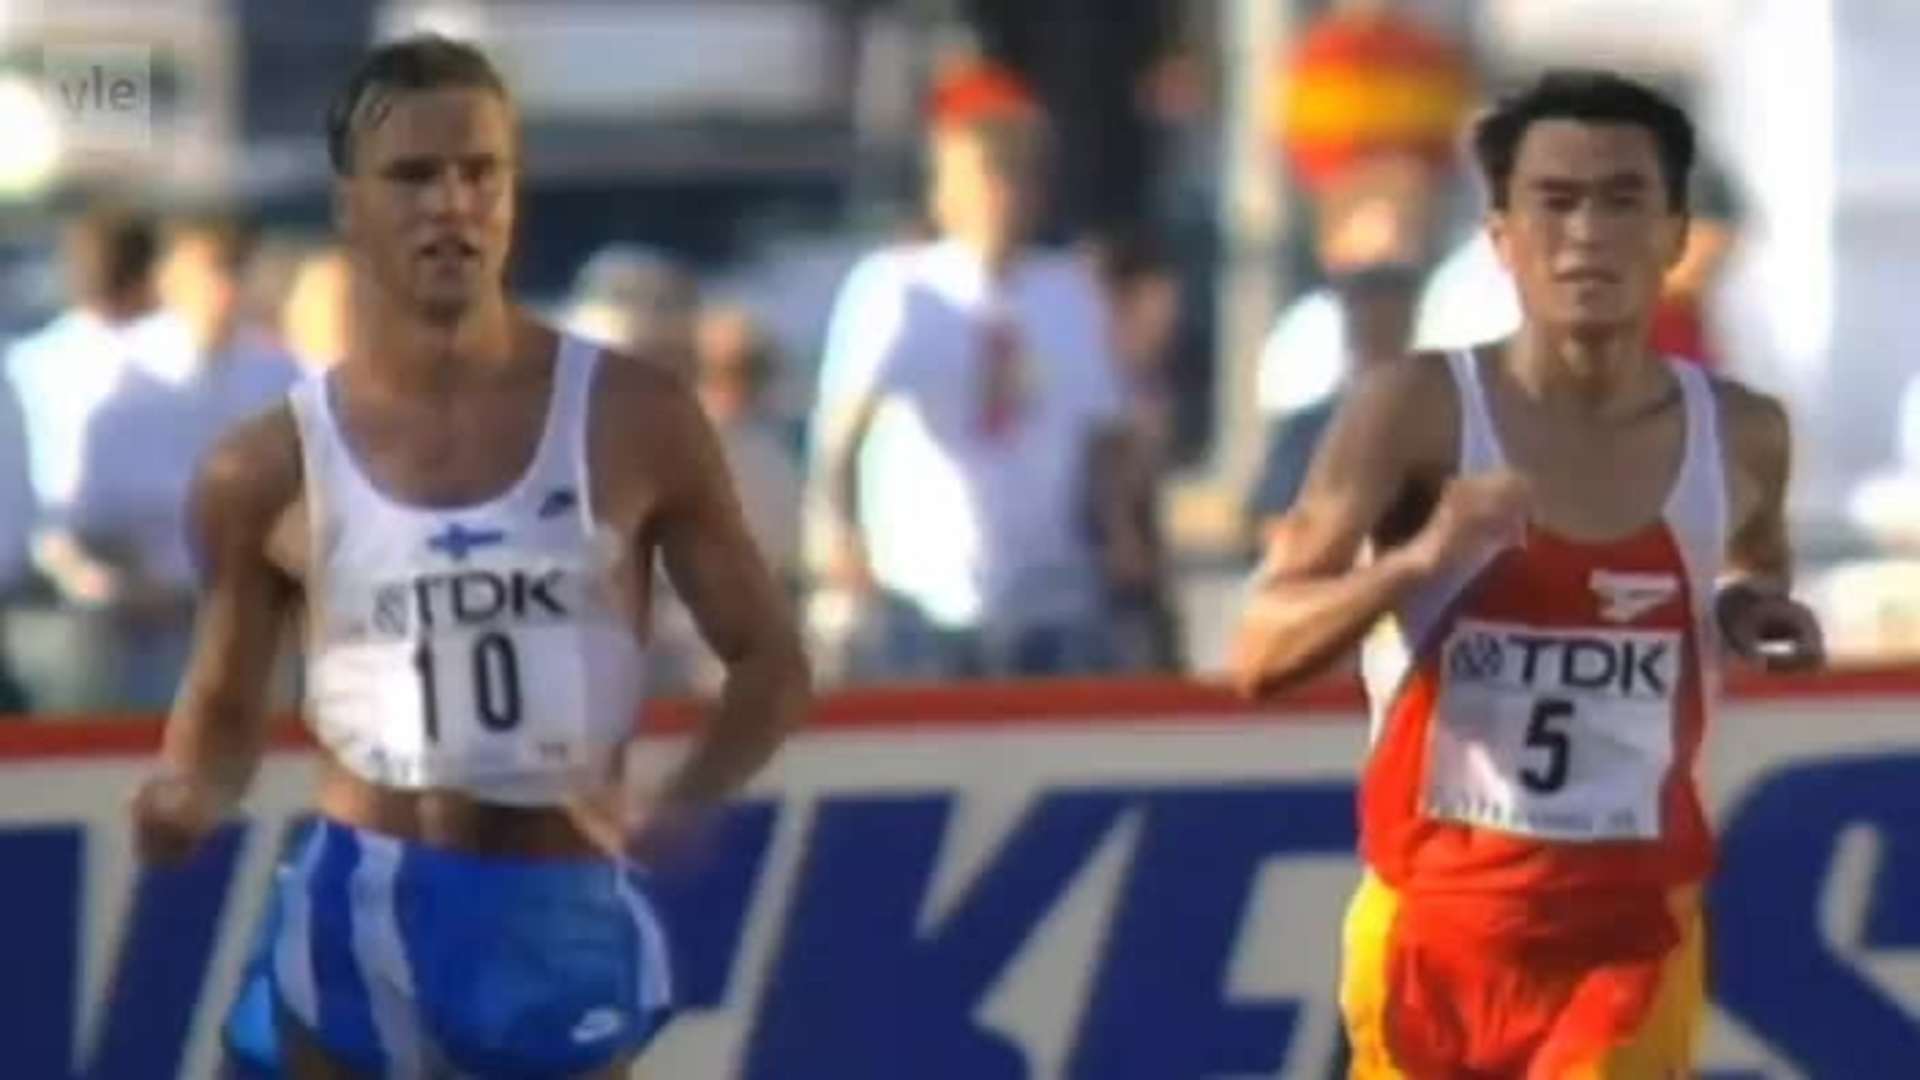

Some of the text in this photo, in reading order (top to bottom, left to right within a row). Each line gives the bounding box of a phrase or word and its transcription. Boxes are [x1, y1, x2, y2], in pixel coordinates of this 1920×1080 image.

[414, 570, 567, 627] TDK
[414, 631, 522, 743] 10
[1507, 633, 1669, 694] TDK
[1518, 698, 1575, 794] 5
